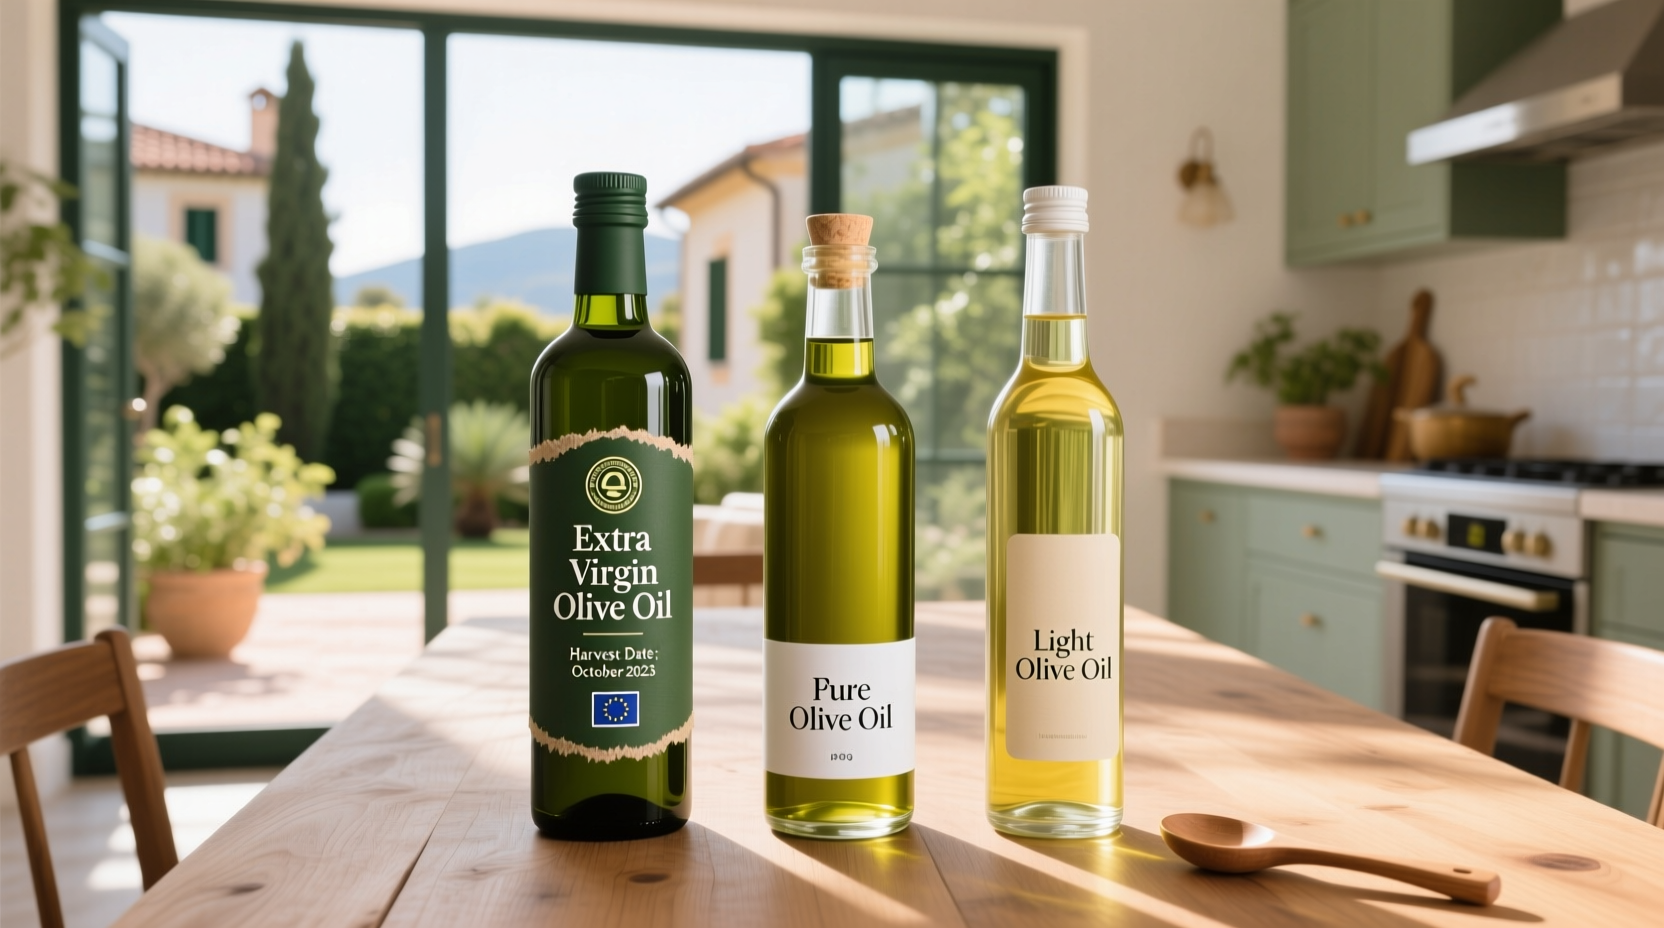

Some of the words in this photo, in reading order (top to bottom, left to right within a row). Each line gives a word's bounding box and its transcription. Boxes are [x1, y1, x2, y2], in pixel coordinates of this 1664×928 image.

[572, 524, 653, 552] Extra
[568, 558, 660, 594] Virgin
[553, 591, 626, 621] Olive
[632, 589, 673, 620] Oil
[570, 646, 621, 662] Harvest
[1034, 628, 1095, 659] Light
[571, 664, 624, 678] October
[1015, 656, 1076, 681] Olive
[1081, 656, 1112, 680] Oil
[812, 677, 871, 702] Pure
[789, 705, 852, 731] Olive
[858, 703, 893, 730] Oil
